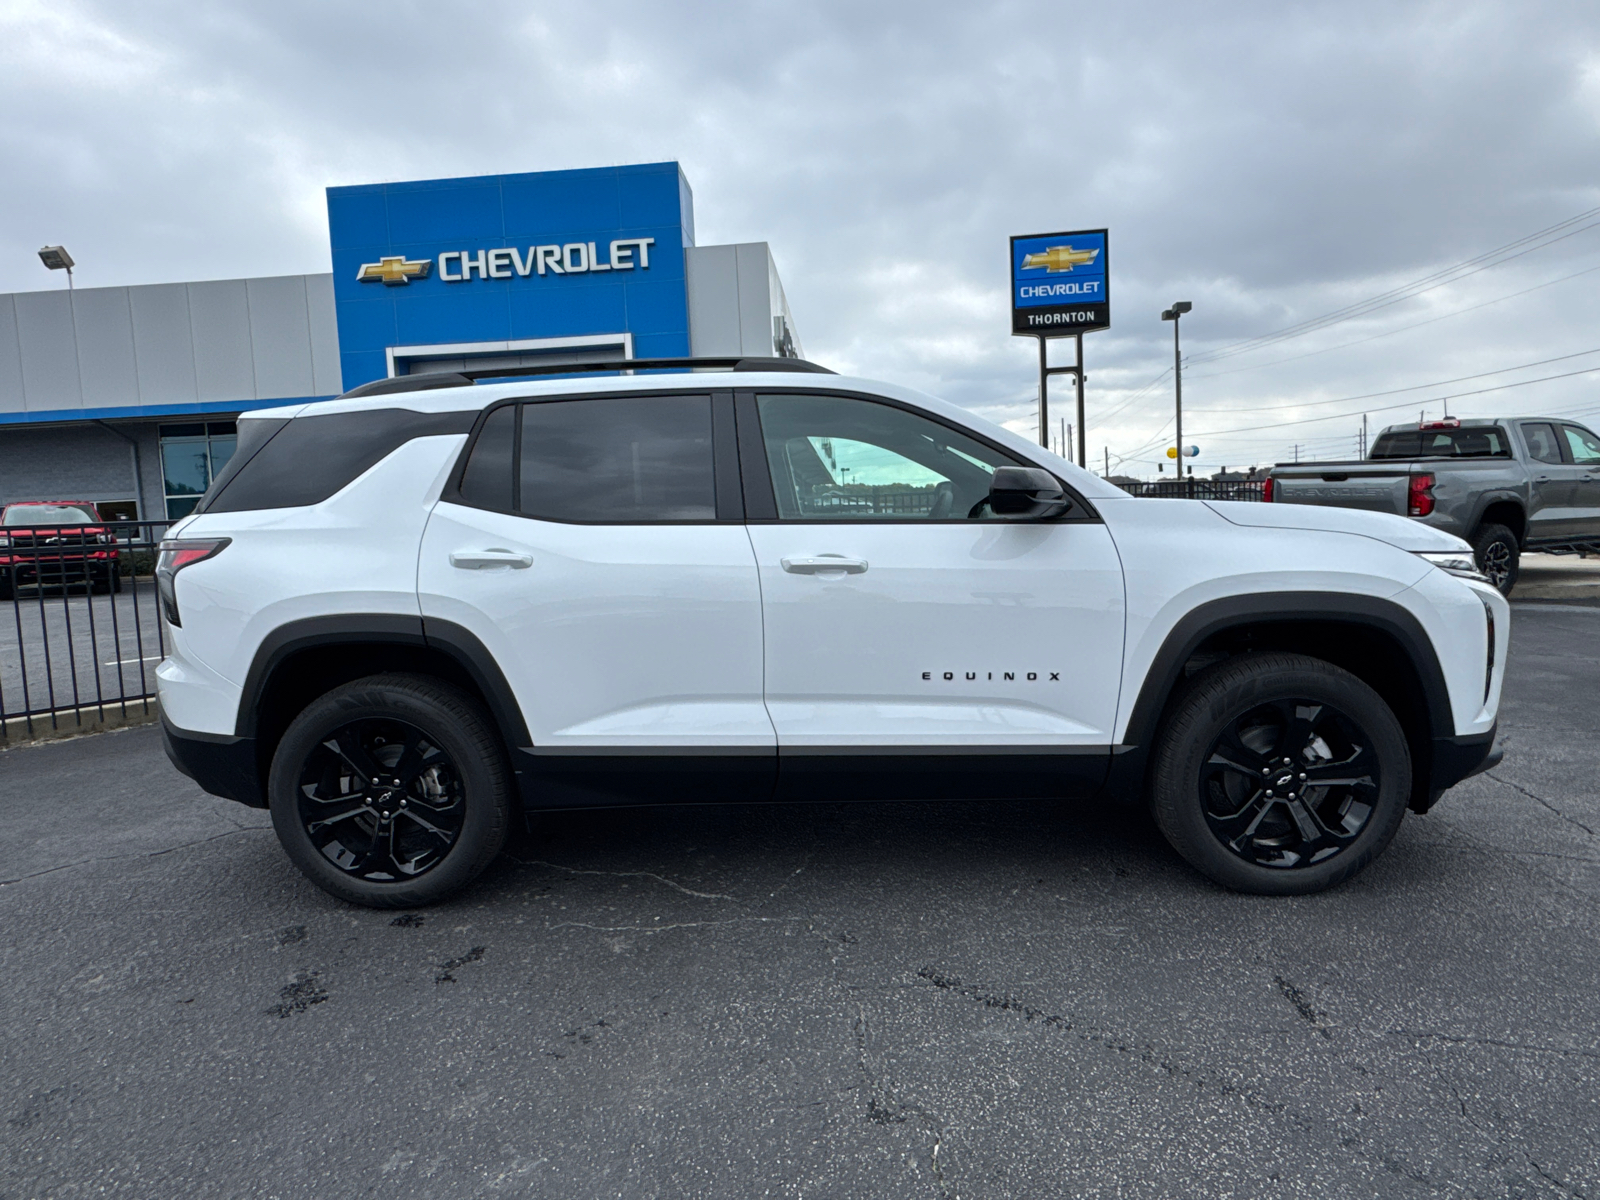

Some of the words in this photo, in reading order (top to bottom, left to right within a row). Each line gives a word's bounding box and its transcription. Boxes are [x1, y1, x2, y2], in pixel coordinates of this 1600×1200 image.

[438, 237, 655, 281] CHEVROLET
[1020, 281, 1100, 298] CHEVROLET
[1028, 311, 1095, 325] THORNTON
[1283, 488, 1390, 497] CHEVROLET
[922, 672, 1060, 681] EQUINOX
